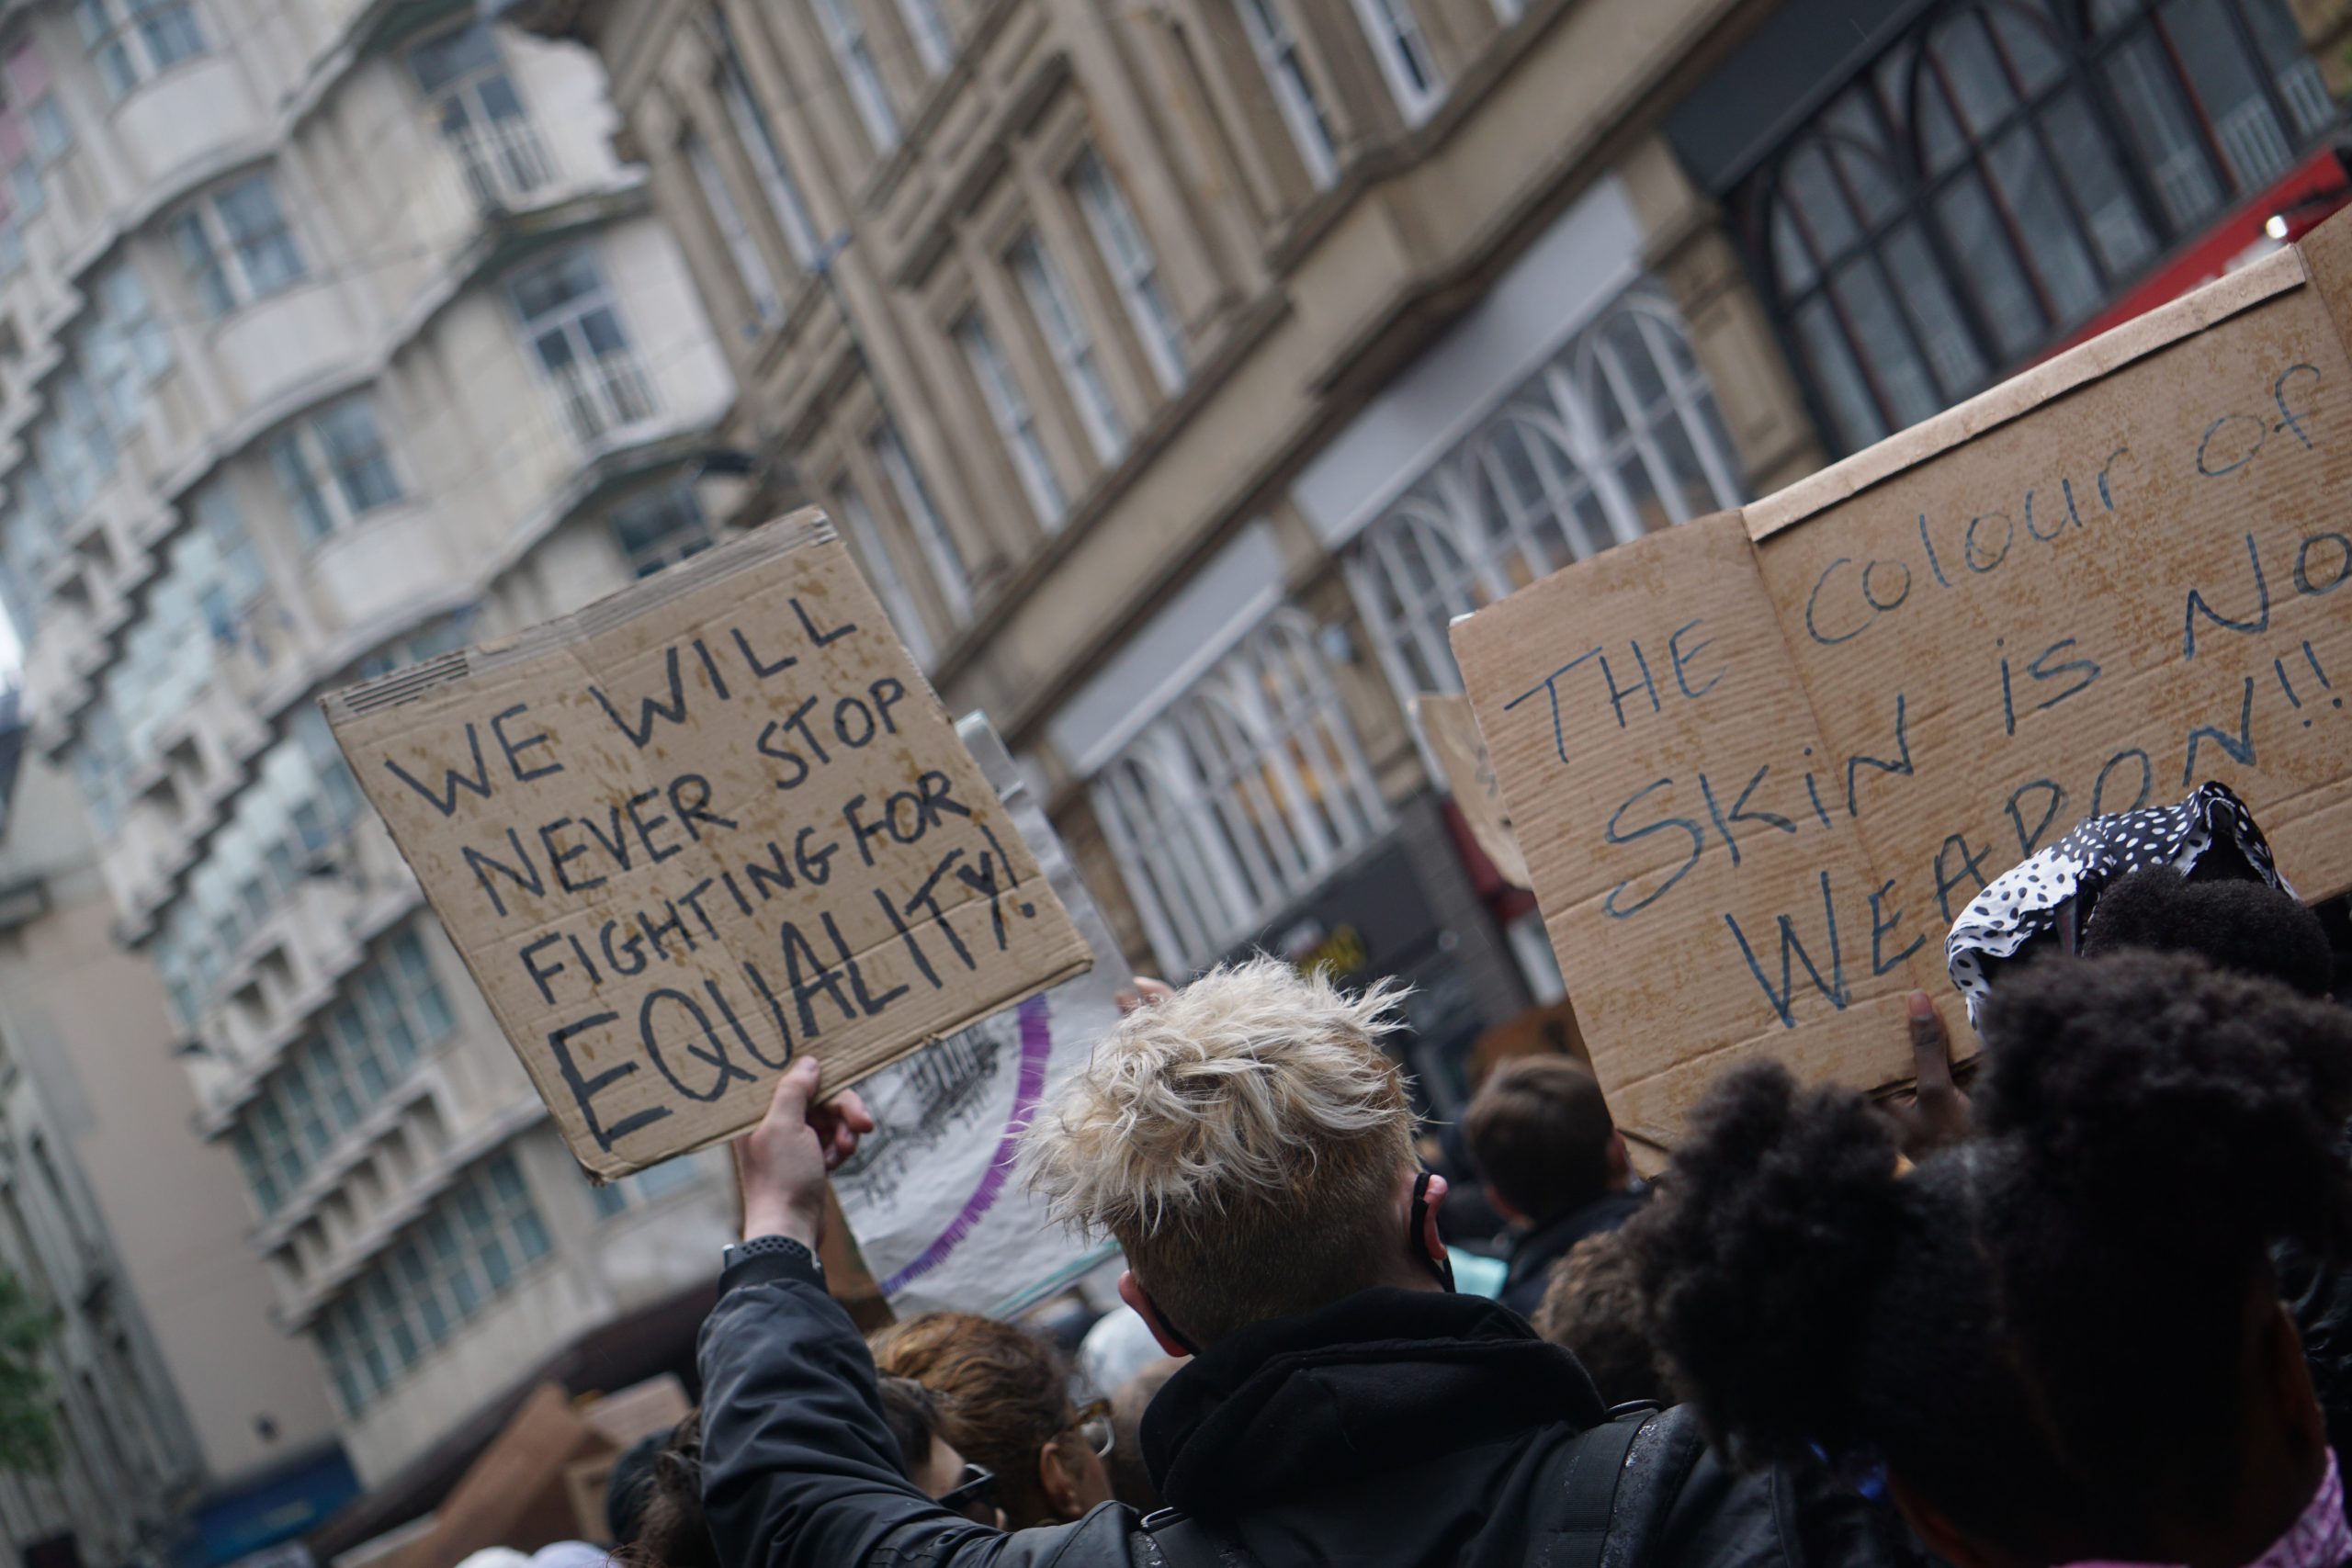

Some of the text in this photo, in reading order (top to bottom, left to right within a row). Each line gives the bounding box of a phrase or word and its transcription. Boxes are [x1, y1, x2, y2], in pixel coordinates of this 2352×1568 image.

[384, 597, 856, 817] WE WILL
[1503, 618, 1726, 763] THE
[2183, 531, 2352, 661] NO
[462, 677, 904, 917] NEVER STOP
[519, 770, 971, 1005] FIGHTING FOR
[1724, 640, 2343, 1030] WEAPON!!
[548, 824, 1036, 1152] EQUALITY!
